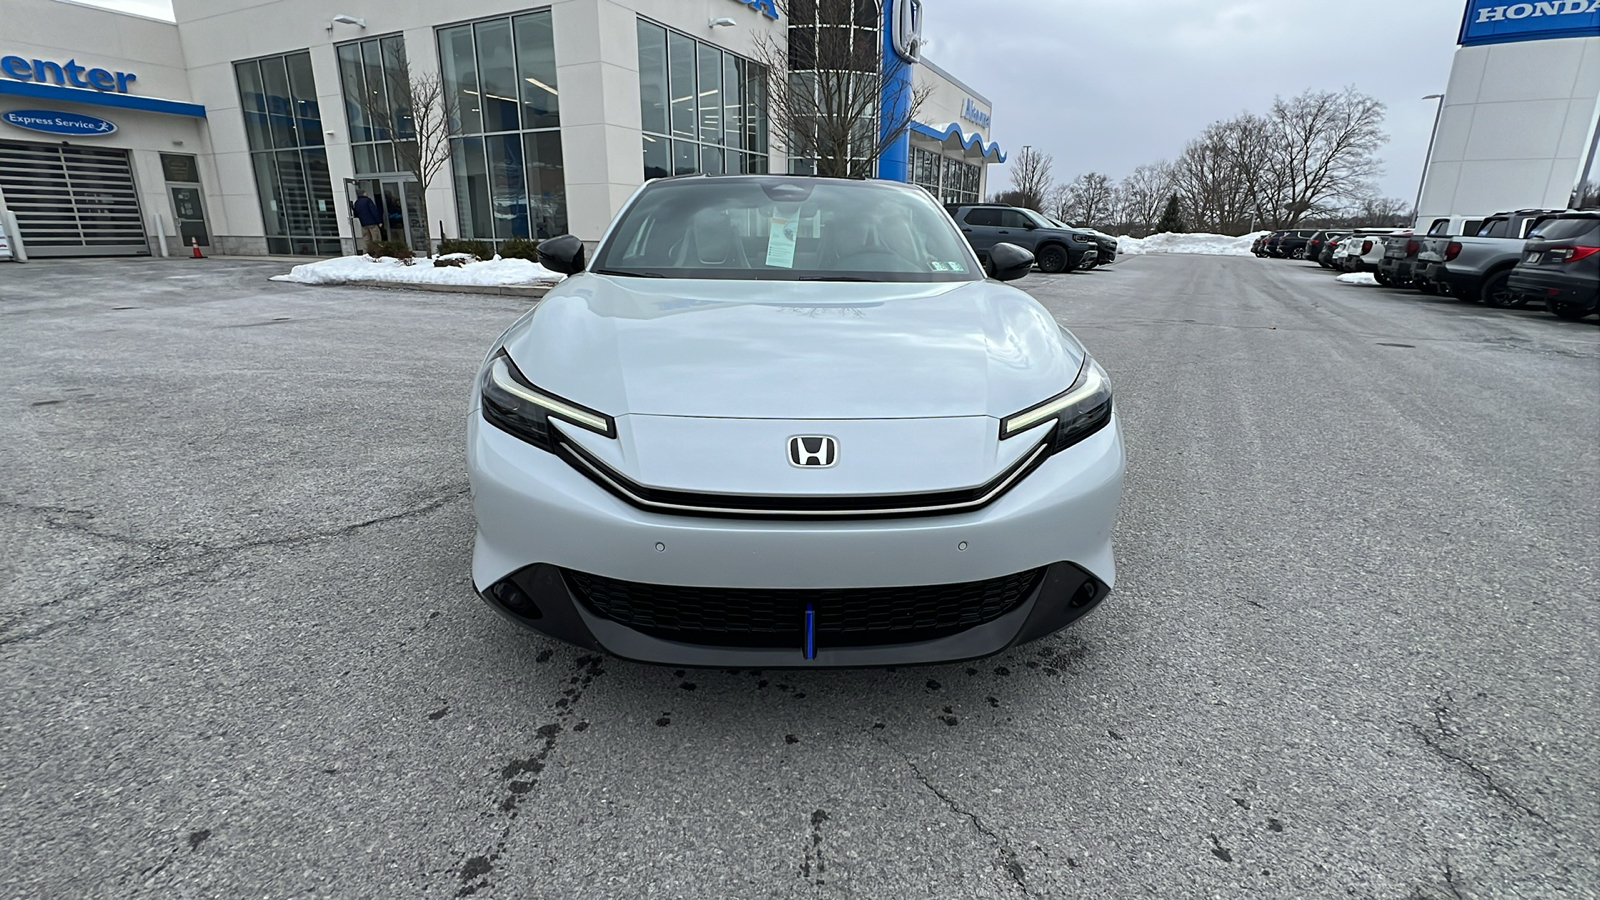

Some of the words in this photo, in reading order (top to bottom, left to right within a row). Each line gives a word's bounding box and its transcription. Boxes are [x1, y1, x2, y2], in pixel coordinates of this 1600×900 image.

[0, 55, 137, 94] enter
[8, 113, 53, 125] Express
[54, 118, 95, 129] Service
